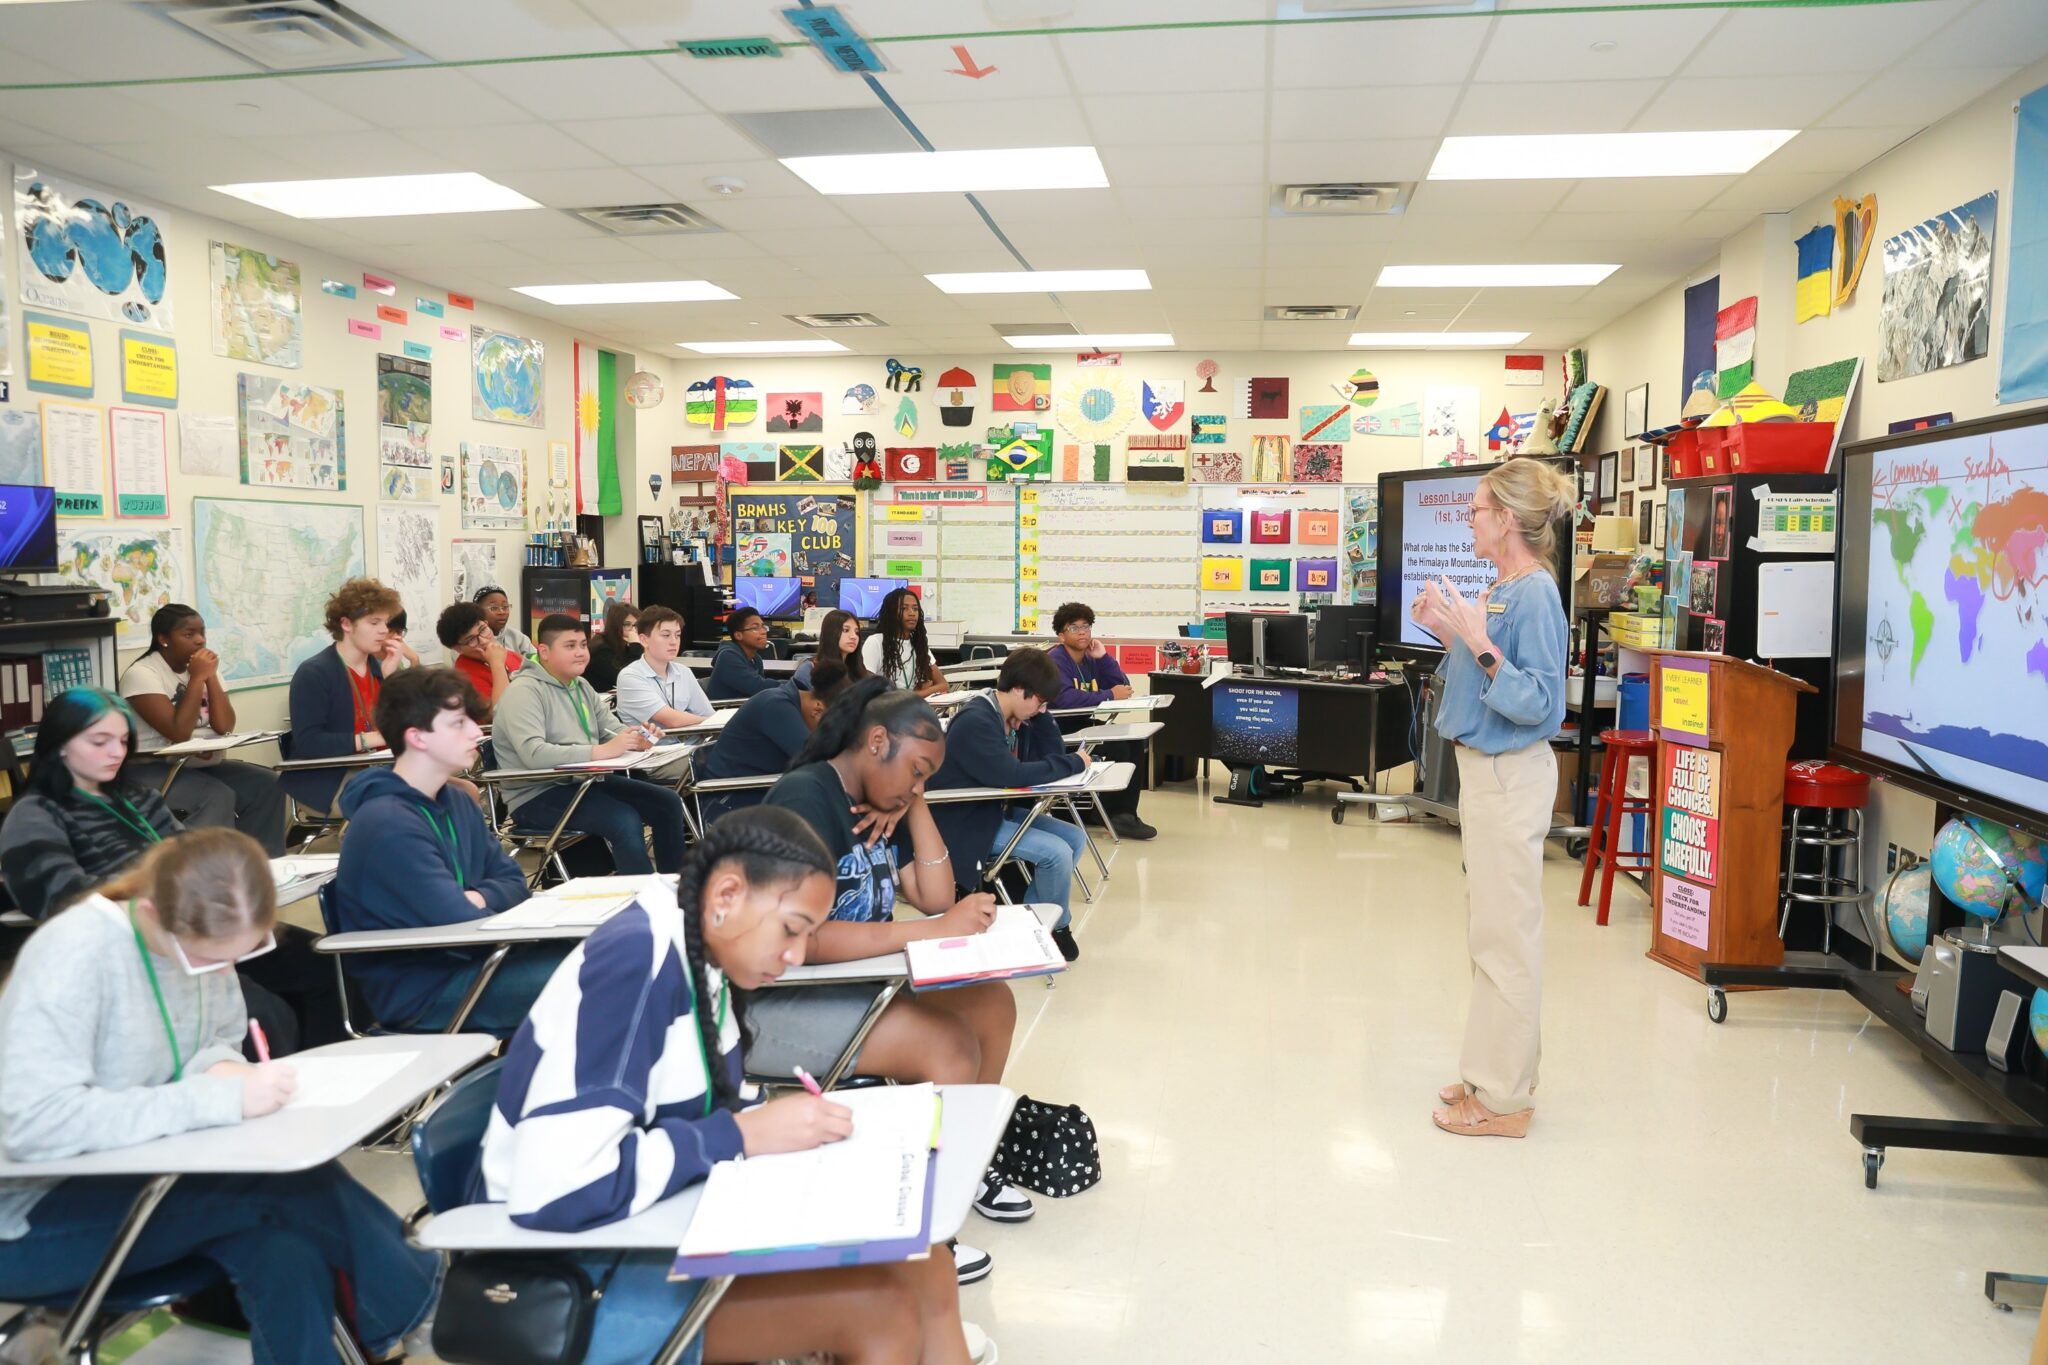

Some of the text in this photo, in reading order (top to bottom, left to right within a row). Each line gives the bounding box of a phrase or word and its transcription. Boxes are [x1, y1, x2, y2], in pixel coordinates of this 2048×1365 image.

[26, 287, 67, 306] Oceans
[1419, 490, 1475, 504] Lesson Laun
[56, 498, 98, 510] PREFIX
[737, 503, 787, 518] BRMHS
[1434, 510, 1453, 525] (1st,
[777, 519, 807, 533] KEY
[1216, 524, 1230, 533] 1ST
[1264, 524, 1279, 533] 3RD
[1312, 525, 1326, 533] 4TH
[802, 535, 842, 550] CLUB
[1023, 544, 1037, 552] 4TH
[1404, 542, 1475, 552] What role has the Sah
[1408, 558, 1418, 567] the
[1419, 558, 1448, 570] Himalaya
[1450, 558, 1487, 568] Mountains
[1023, 568, 1037, 576] 5TH
[1216, 571, 1230, 580] 5TH
[1264, 573, 1279, 582] 6TH
[1312, 574, 1326, 582] 8TH
[1404, 572, 1442, 584] establishing
[1022, 594, 1037, 602] 6TH
[1460, 590, 1479, 599] world
[1022, 620, 1037, 628] 8TH
[1682, 675, 1702, 686] LEARNER
[1676, 750, 1708, 774] LIFE IS
[1672, 768, 1711, 795] FULL OF
[1668, 787, 1713, 816] CHOICES.
[1671, 812, 1707, 848] CHOOSE
[1664, 838, 1712, 879] CAREFULLY.
[1672, 892, 1699, 906] CHECK FOR
[1665, 898, 1706, 916] UNDERSTANDING
